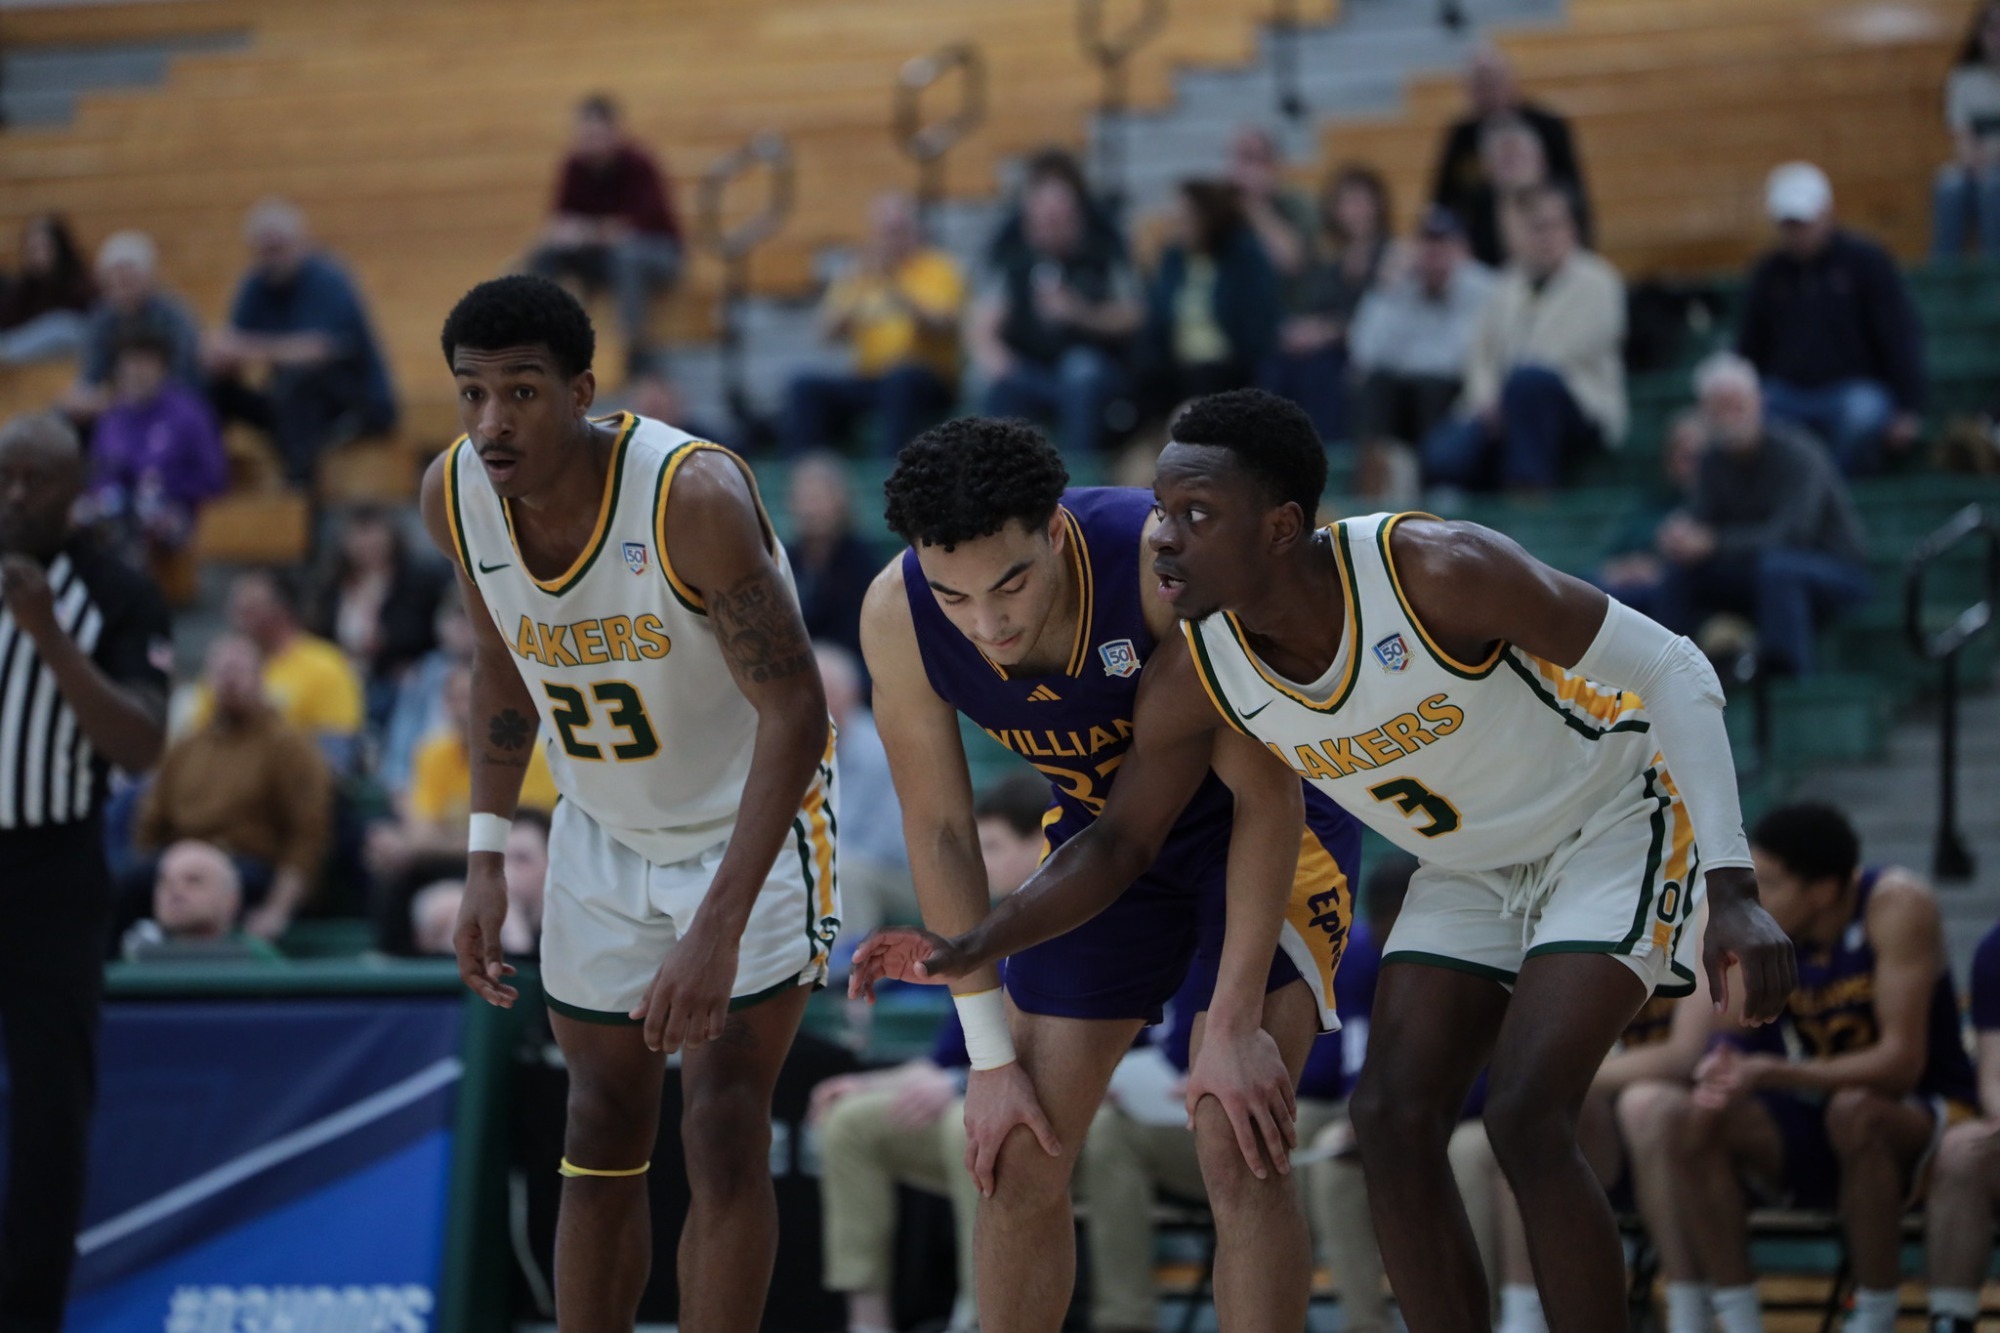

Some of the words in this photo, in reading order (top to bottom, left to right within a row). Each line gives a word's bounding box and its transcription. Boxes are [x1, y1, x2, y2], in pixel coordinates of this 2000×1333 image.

[627, 549, 643, 563] 50
[1108, 648, 1130, 664] 50
[1382, 642, 1403, 661] 50
[541, 679, 663, 763] 23
[1366, 775, 1462, 839] 3
